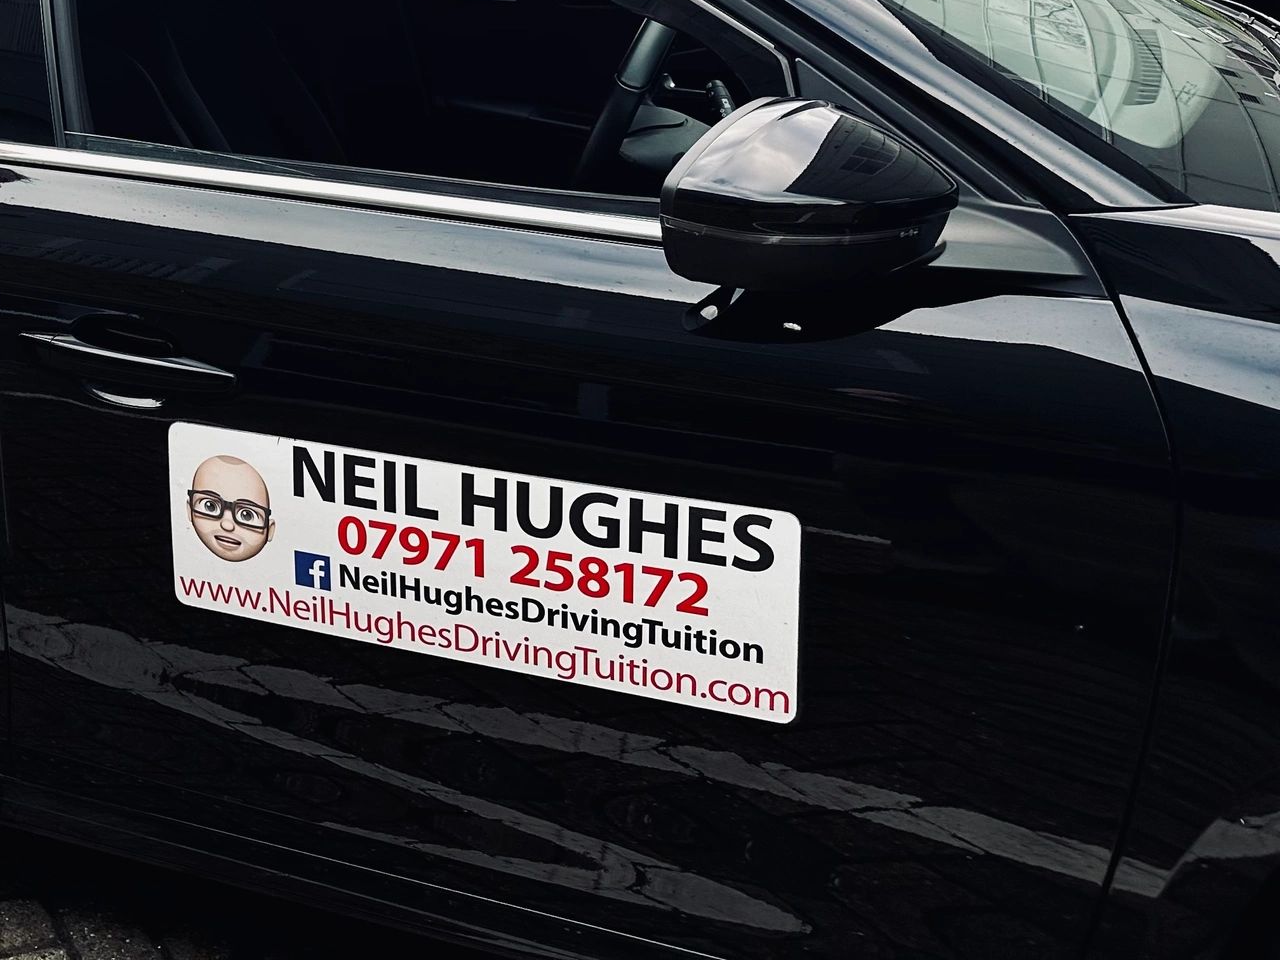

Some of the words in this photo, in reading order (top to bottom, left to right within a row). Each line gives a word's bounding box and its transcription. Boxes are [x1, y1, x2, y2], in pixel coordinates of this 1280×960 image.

[292, 445, 439, 521] NEIL
[460, 472, 776, 573] HUGHES
[337, 515, 486, 578] 07971
[509, 544, 710, 617] 258172
[179, 574, 791, 715] www.NeilHughesDrivingTuition.com
[339, 563, 766, 664] NeilHughesDrivingTuition
